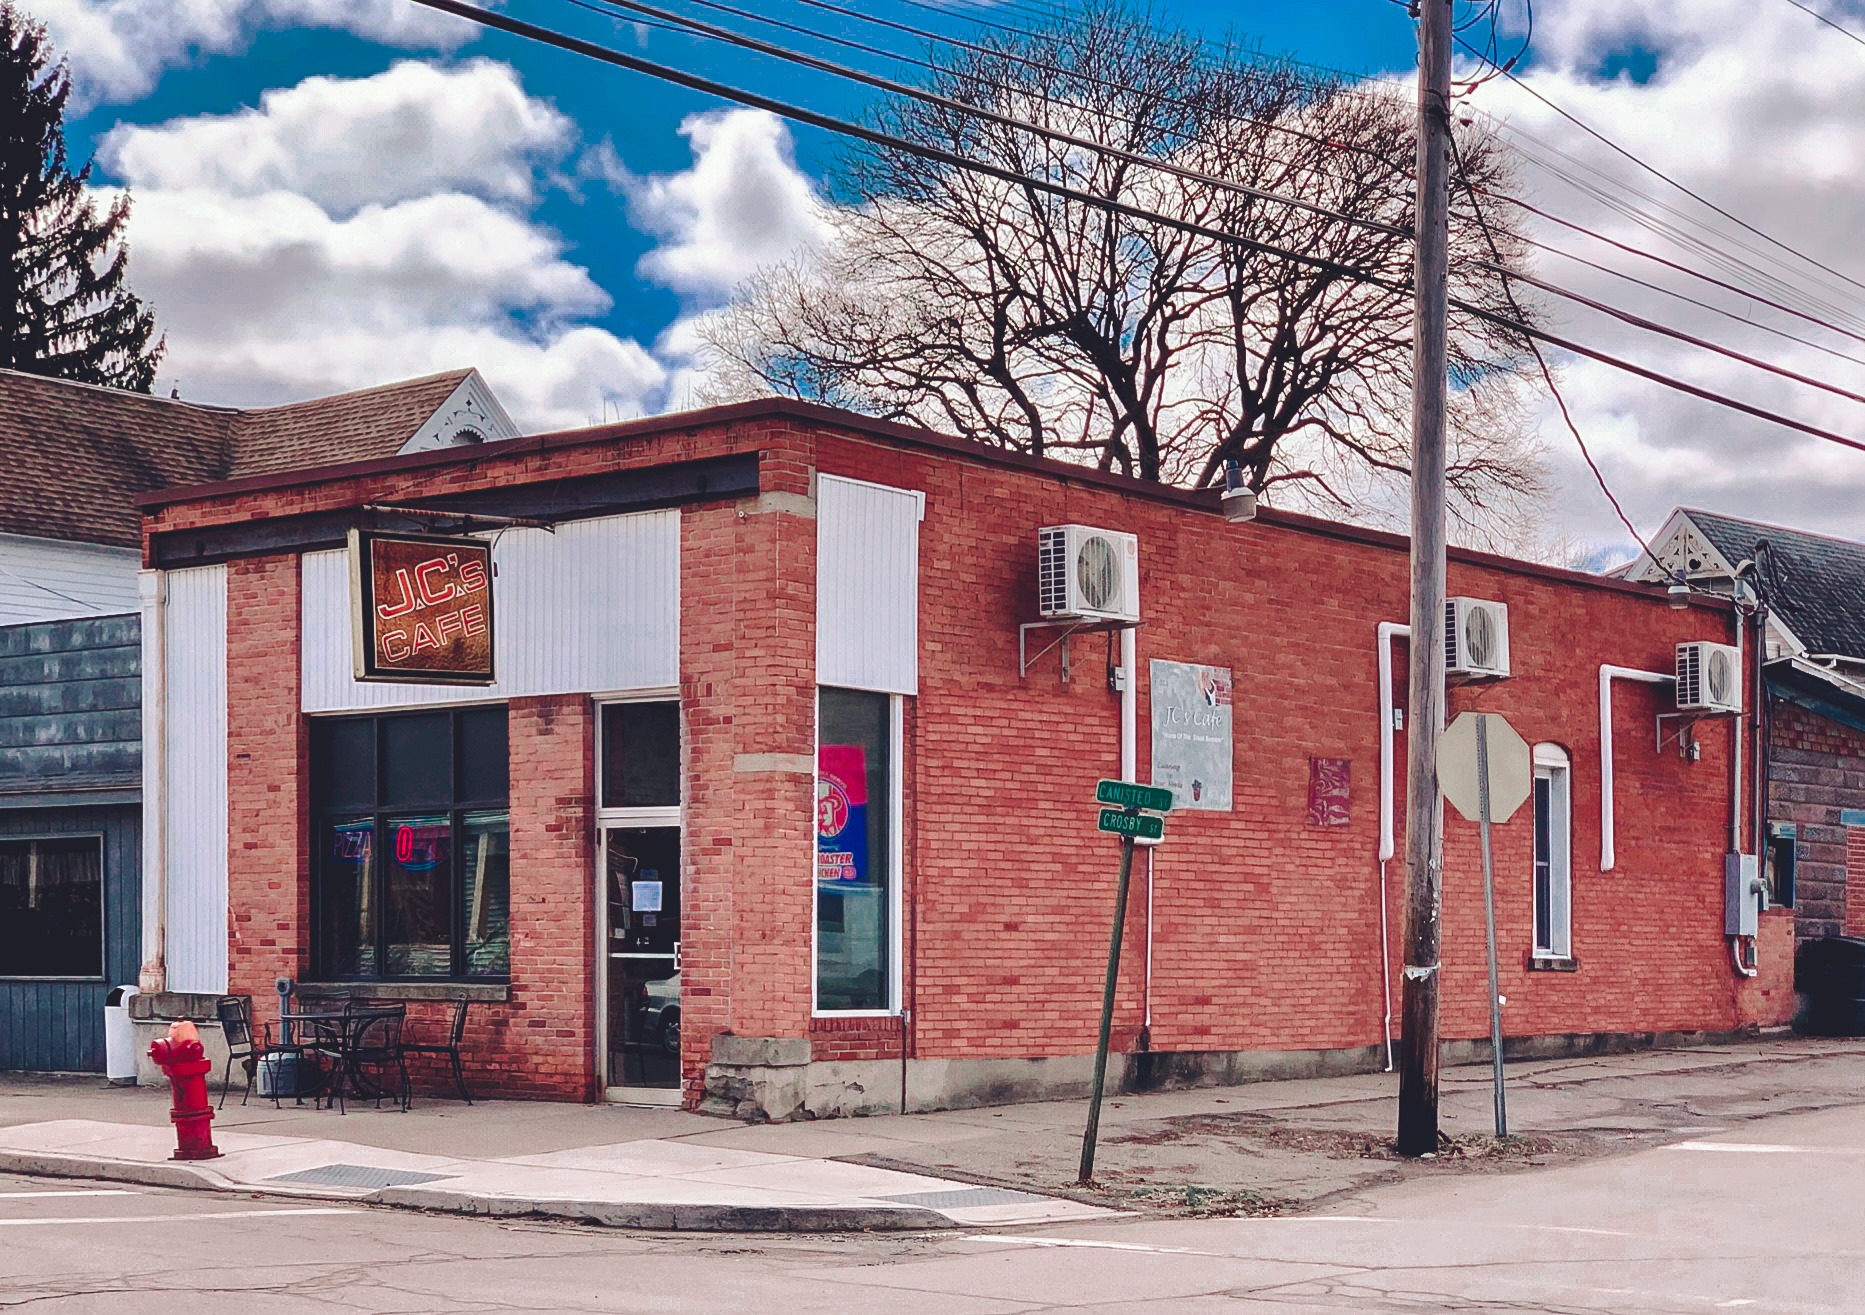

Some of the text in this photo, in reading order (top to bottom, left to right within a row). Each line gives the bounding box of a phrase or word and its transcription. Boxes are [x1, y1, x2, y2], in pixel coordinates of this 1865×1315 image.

[382, 604, 486, 662] CAFE
[1099, 785, 1151, 805] CANISTEO
[1103, 813, 1158, 833] CROSBY ST
[334, 831, 372, 858] PIZZA
[818, 852, 852, 865] OASTER
